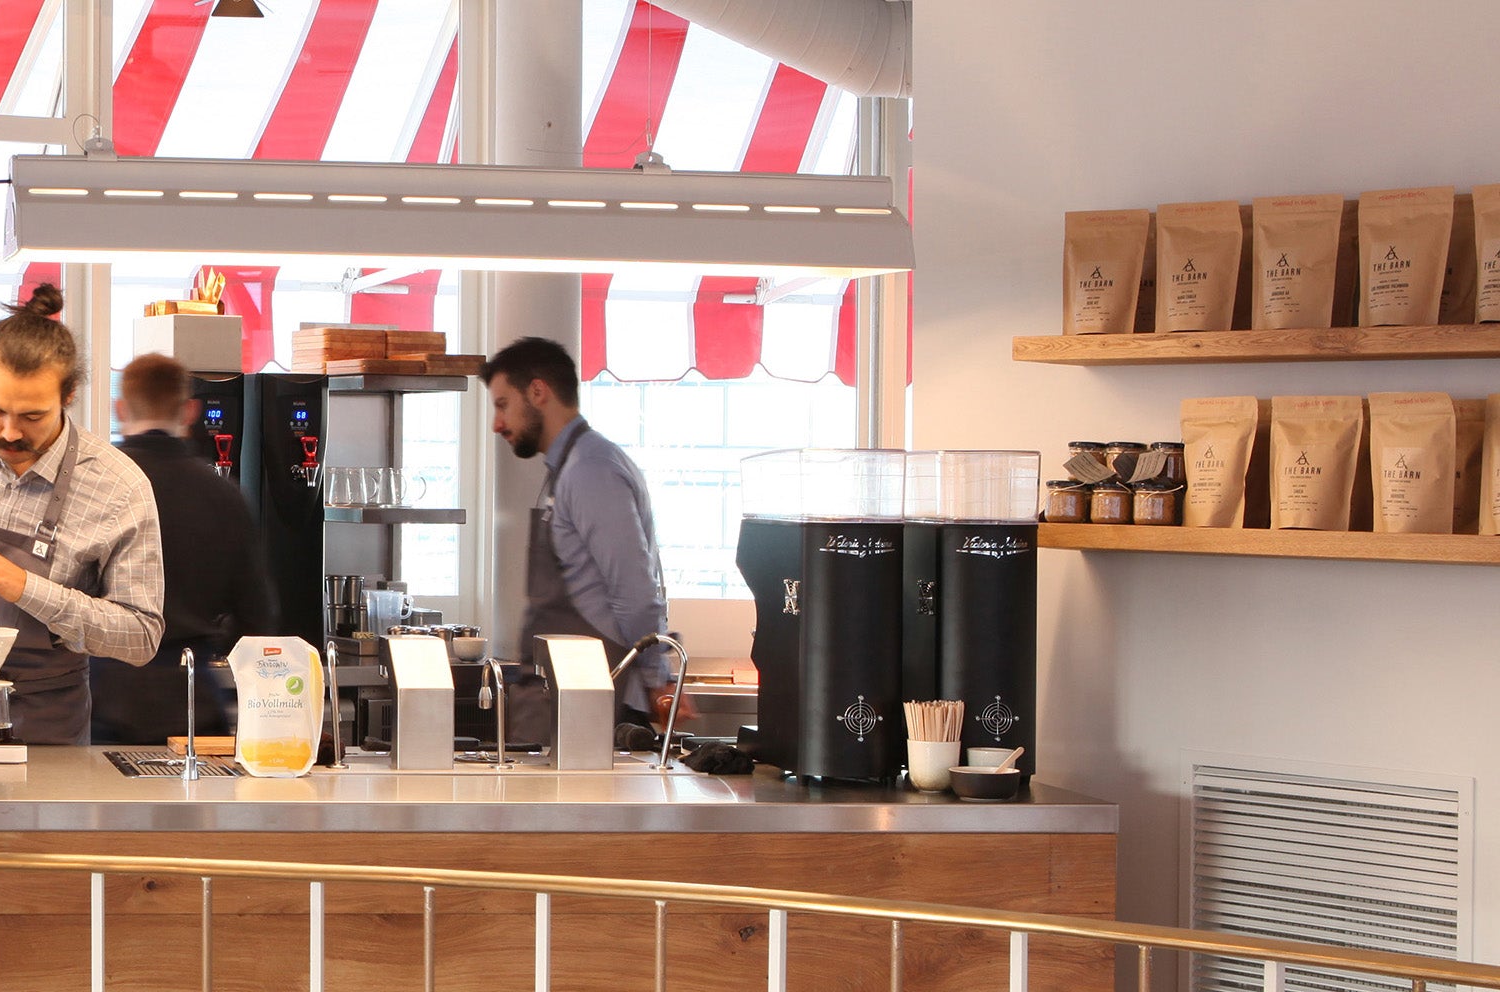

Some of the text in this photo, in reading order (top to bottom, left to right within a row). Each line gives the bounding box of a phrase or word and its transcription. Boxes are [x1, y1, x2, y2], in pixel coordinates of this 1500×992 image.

[1373, 260, 1411, 272] THE BARN
[1484, 261, 1496, 270] THE
[1172, 272, 1208, 282] THE BARN
[1267, 268, 1301, 278] THE BARN
[1080, 280, 1113, 289] THE BARN
[208, 410, 221, 418] 100
[296, 411, 307, 419] 68
[1301, 467, 1322, 475] BARN
[1399, 471, 1421, 479] BARN
[262, 698, 303, 709] Vollmilch
